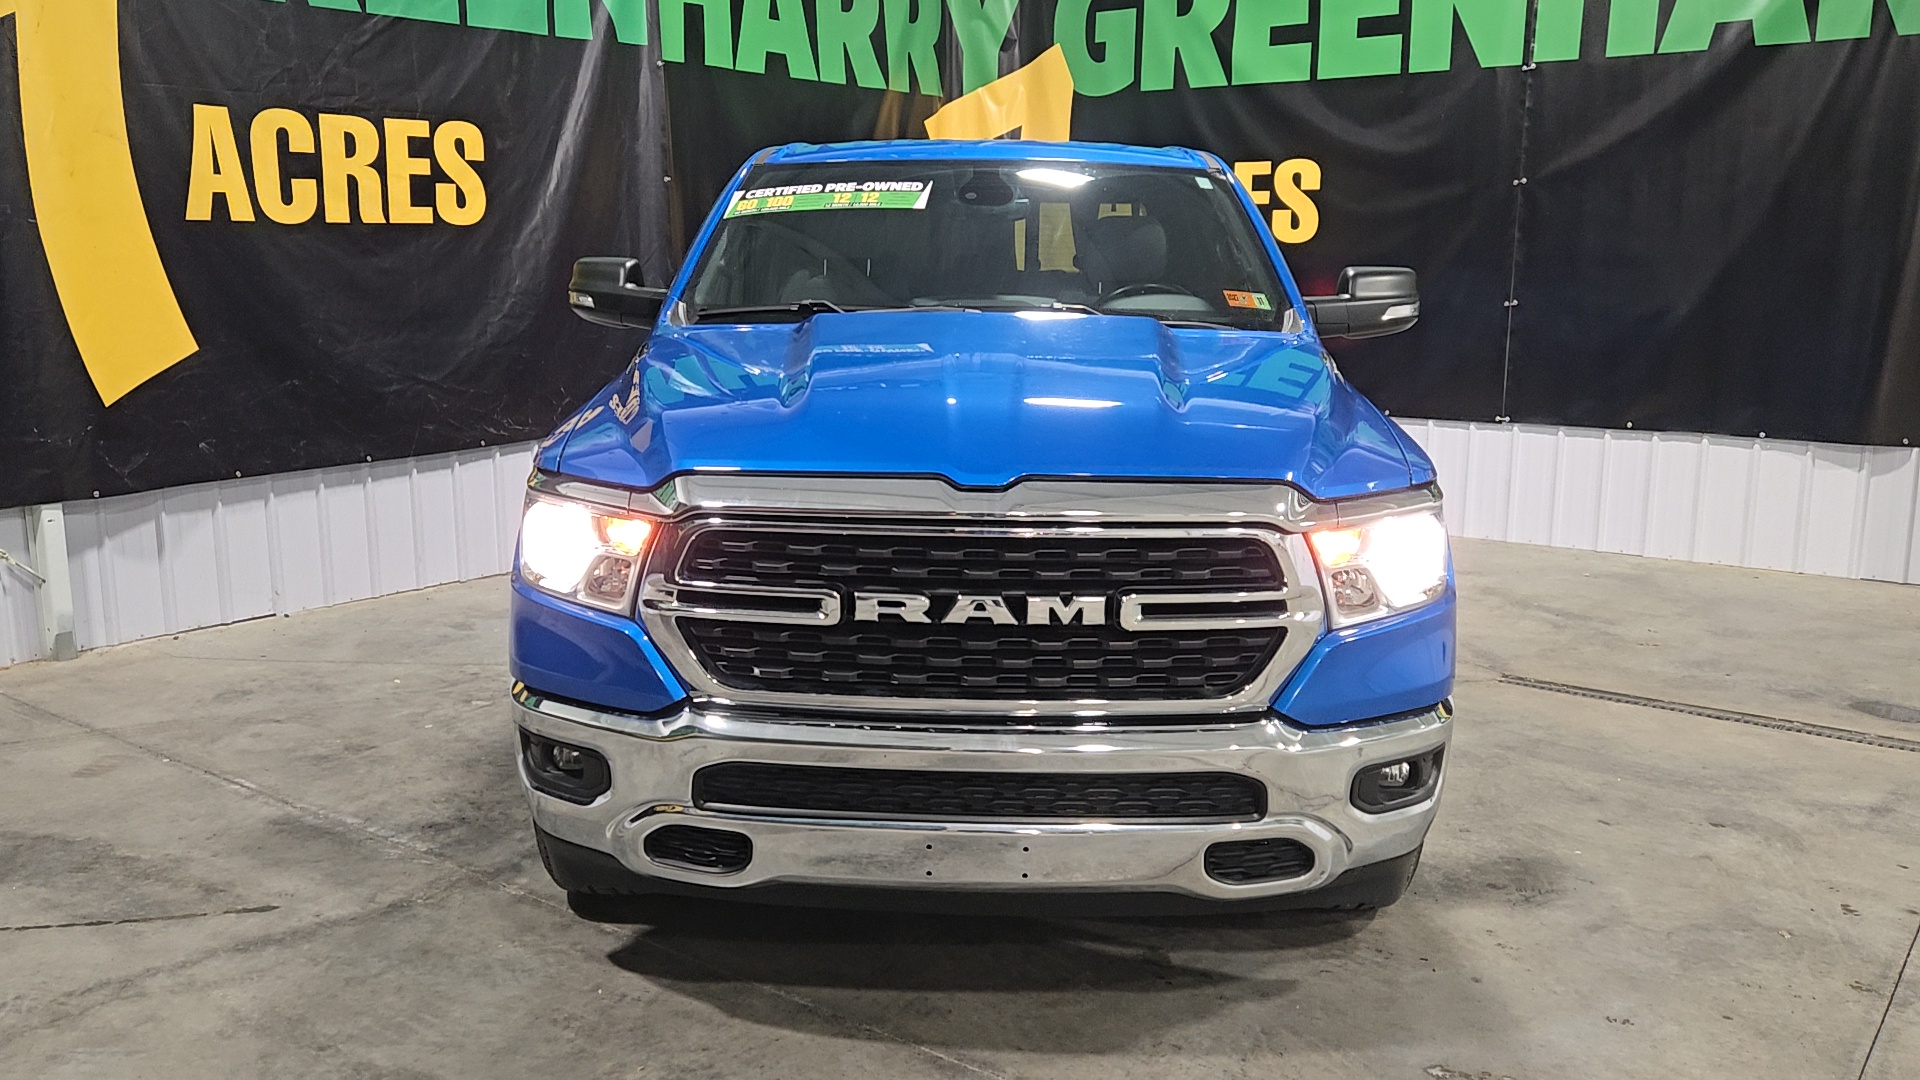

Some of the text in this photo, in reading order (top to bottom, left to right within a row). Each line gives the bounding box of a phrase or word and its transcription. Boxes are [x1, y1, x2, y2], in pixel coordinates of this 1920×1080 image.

[186, 104, 487, 226] ACRES
[745, 181, 924, 199] CERTIFIED PRE-OWNED
[766, 195, 794, 208] 100
[833, 193, 852, 204] 12
[861, 192, 880, 203] 12
[853, 591, 1106, 625] RAM
